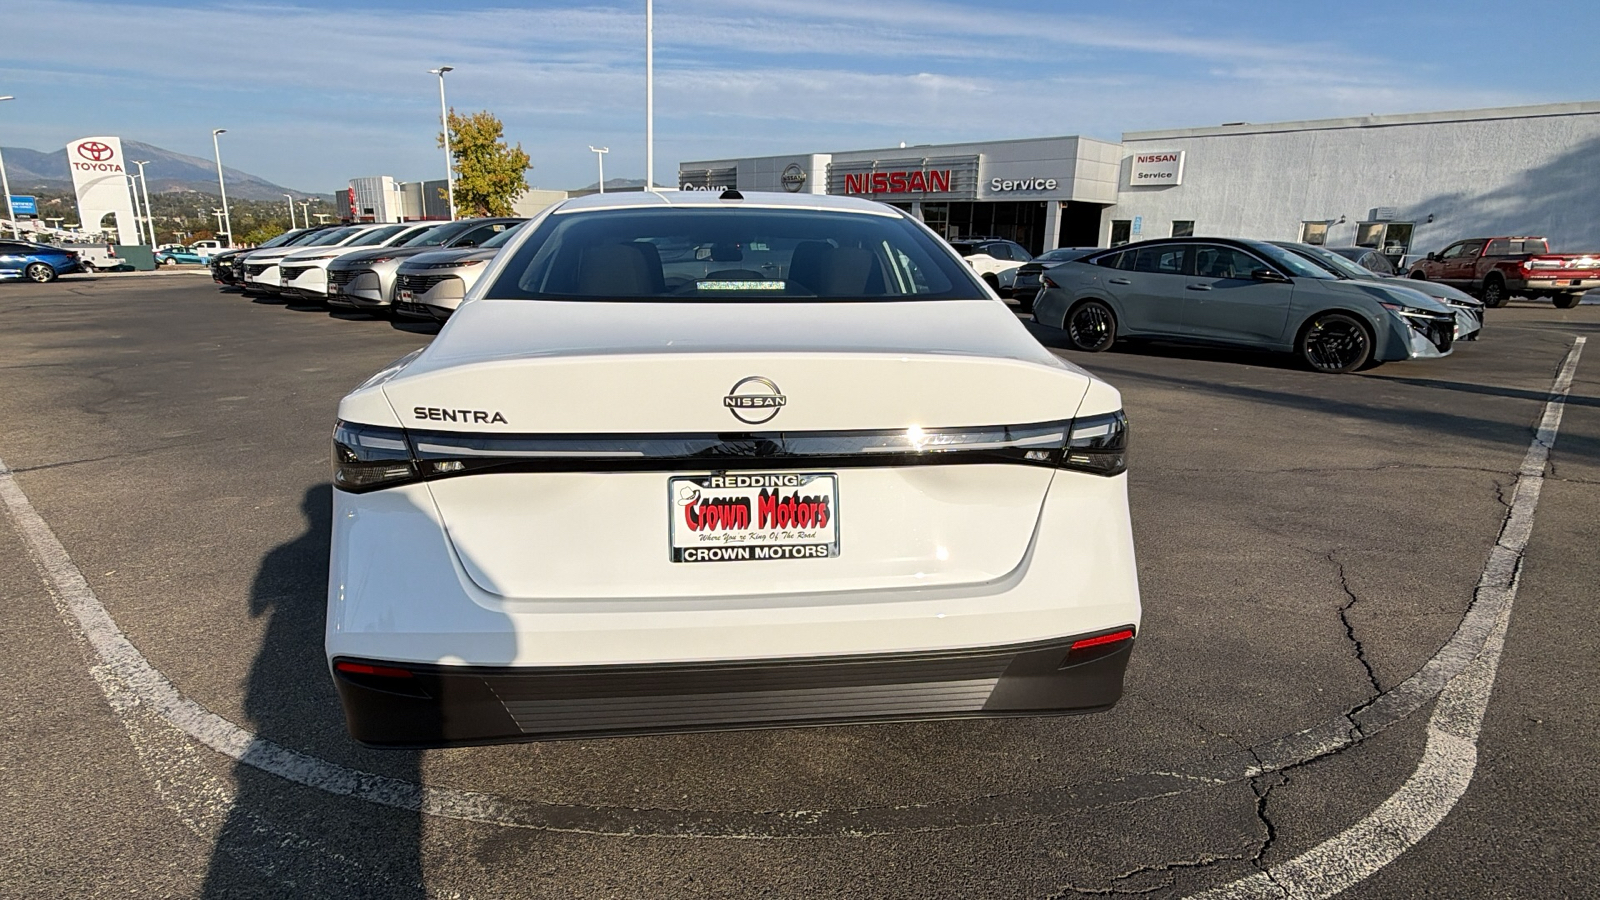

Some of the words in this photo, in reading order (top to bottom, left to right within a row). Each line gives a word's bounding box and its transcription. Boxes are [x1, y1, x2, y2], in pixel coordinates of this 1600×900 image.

[1137, 155, 1177, 163] NISSAN
[73, 162, 123, 172] TOYOTA
[845, 169, 951, 194] NISSAN
[991, 177, 1057, 191] Service
[725, 397, 785, 406] NISSAN
[413, 406, 508, 424] SENTRA
[711, 476, 798, 487] REDDING
[684, 497, 751, 531] Crown
[758, 490, 829, 529] Motors
[699, 532, 721, 541] Where
[749, 532, 766, 541] King
[769, 531, 779, 541] Of
[781, 531, 794, 539] The
[797, 531, 817, 539] Road
[684, 547, 750, 561] CROWN
[754, 545, 828, 559] MOTORS
